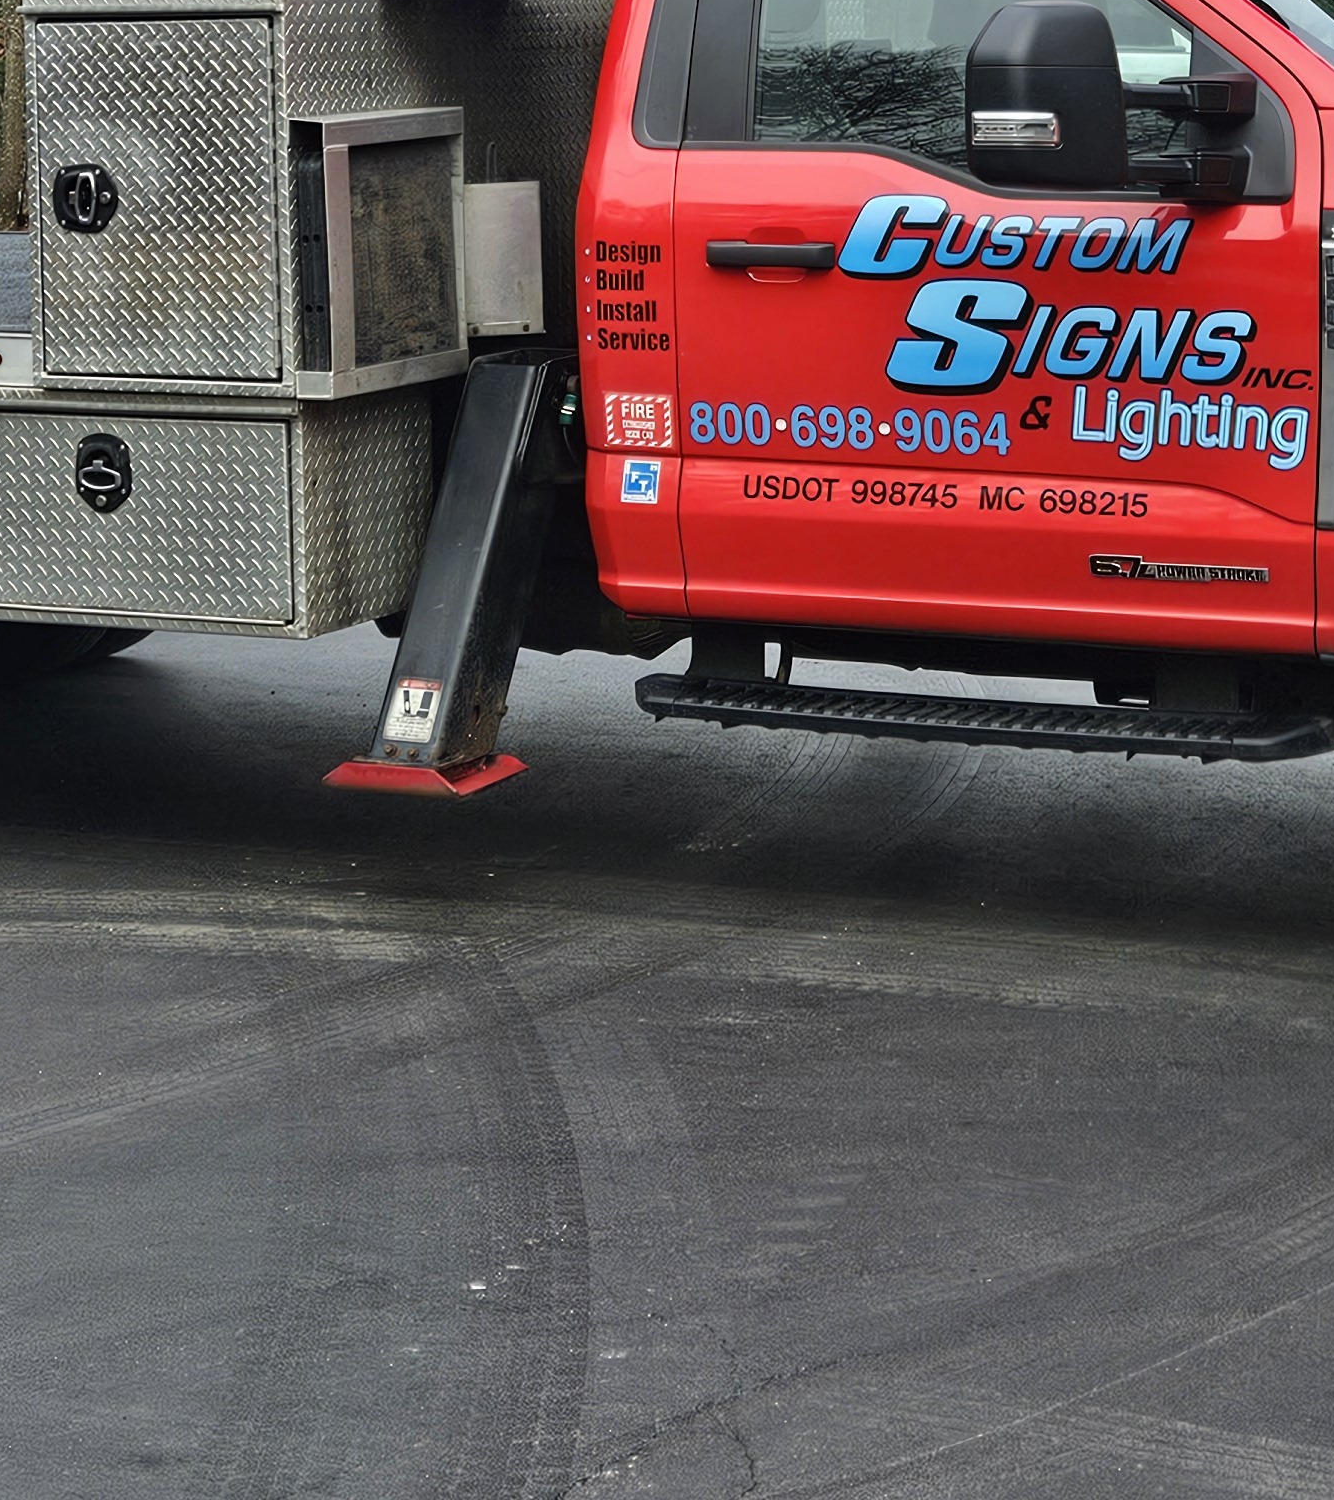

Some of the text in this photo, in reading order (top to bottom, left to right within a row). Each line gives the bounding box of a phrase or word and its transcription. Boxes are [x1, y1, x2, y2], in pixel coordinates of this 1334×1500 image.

[837, 194, 1195, 280] CUSTOM
[596, 240, 661, 265] Design
[596, 268, 644, 291] Build
[596, 298, 657, 322] Install
[597, 327, 670, 351] Service
[885, 277, 1315, 396] SIGNS INC.
[621, 403, 655, 419] FIRE
[1019, 384, 1310, 471] & Lighting
[743, 474, 1149, 518] USDOT 998745 MC 698215
